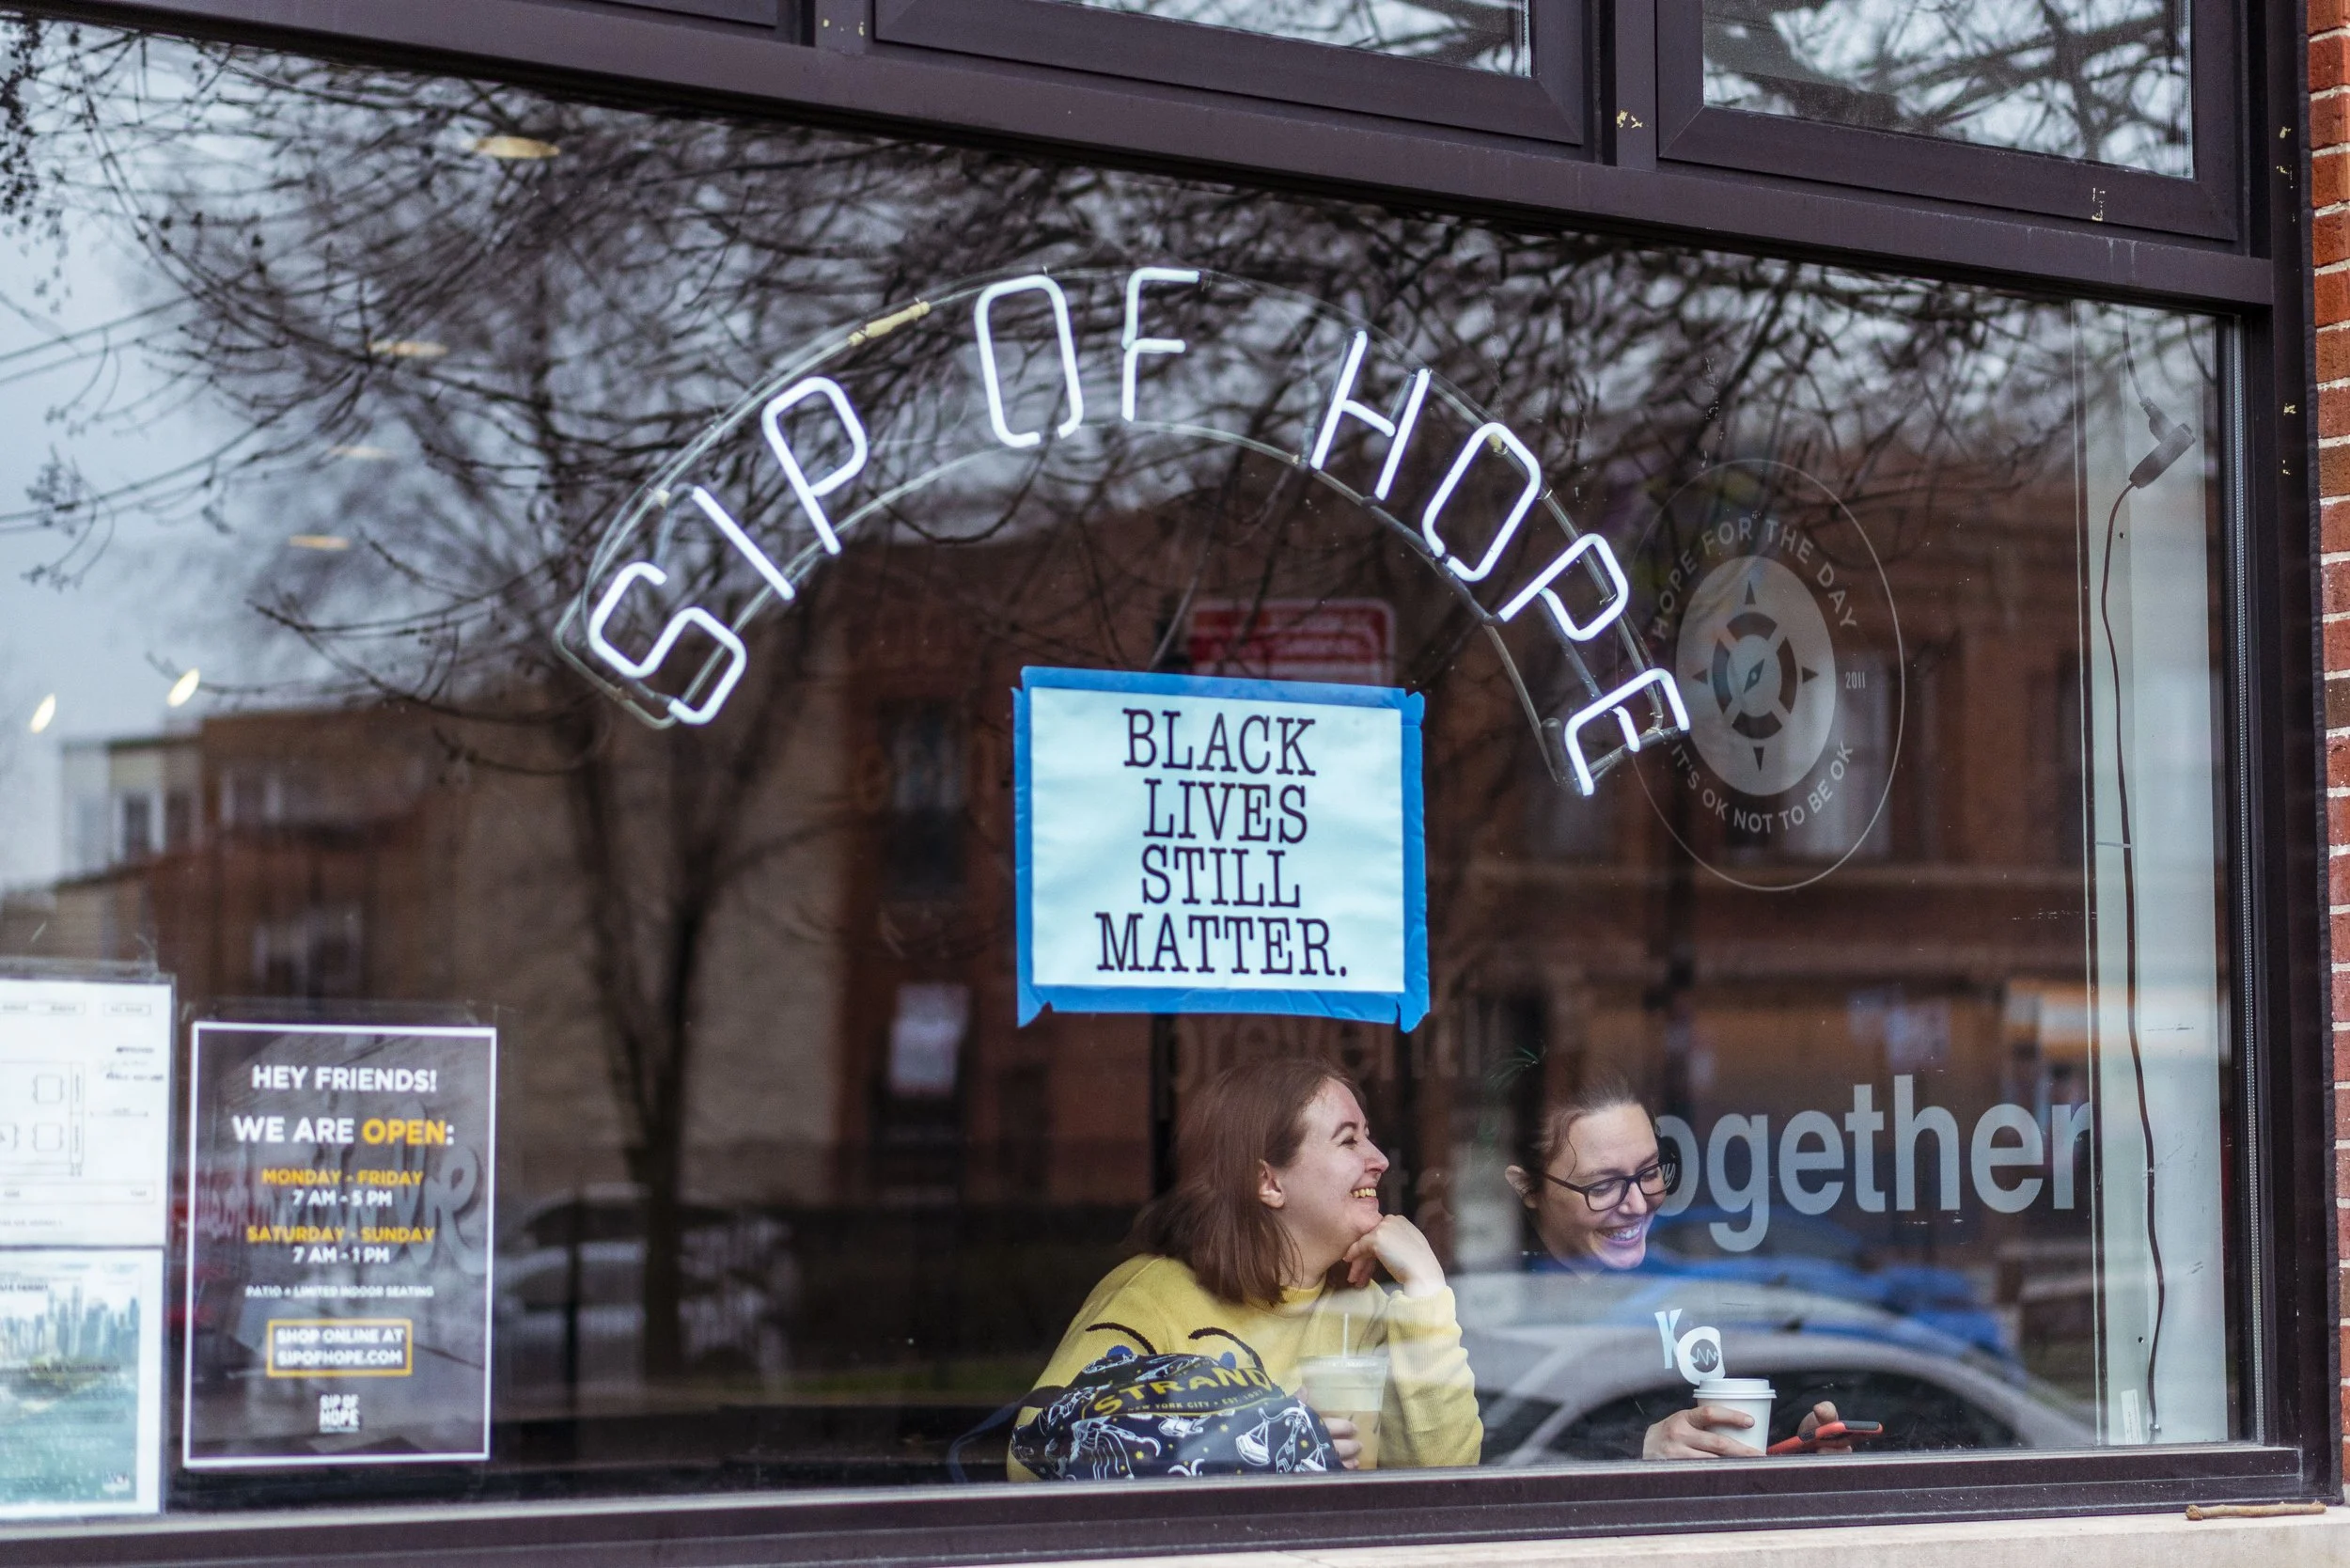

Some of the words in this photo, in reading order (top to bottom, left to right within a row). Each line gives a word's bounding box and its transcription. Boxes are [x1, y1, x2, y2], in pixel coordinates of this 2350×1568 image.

[587, 376, 870, 726] SIP
[973, 266, 1200, 448] OF
[1309, 329, 1691, 797] HOPE
[1653, 548, 1700, 641] HOPE
[1700, 517, 1753, 557] FOR
[1763, 519, 1814, 561] THE
[1816, 565, 1858, 631] DAY
[1844, 671, 1867, 689] 2011
[1121, 707, 1317, 777] BLACK
[1670, 741, 1701, 790] IT'S
[1702, 788, 1730, 823] OK
[1732, 807, 1774, 834] NOT
[1778, 804, 1806, 828] TO
[1808, 778, 1834, 815] BE
[1829, 740, 1854, 782] OK
[1142, 777, 1308, 845] LIVES
[1140, 843, 1301, 909] STILL
[1094, 911, 1348, 979] MATTER.
[251, 1064, 308, 1090] HEY
[315, 1066, 437, 1093] FRIENDS!
[231, 1115, 285, 1142] WE
[292, 1117, 354, 1144] ARE
[362, 1118, 455, 1146] OPEN:
[261, 1168, 342, 1186] MONDAY
[357, 1169, 424, 1186] FRIDAY
[1654, 1074, 2092, 1252] ogether
[292, 1189, 305, 1206] 7
[307, 1189, 337, 1206] AM
[351, 1189, 364, 1207] 5
[367, 1190, 393, 1207] PM
[246, 1225, 346, 1243] SATURDAY
[360, 1226, 435, 1243] SUNDAY
[292, 1247, 305, 1263] 7
[307, 1247, 337, 1263] AM
[352, 1247, 360, 1262] 1
[363, 1247, 391, 1263] PM
[244, 1285, 282, 1297] PATIO
[385, 1285, 435, 1297] SEATING
[275, 1328, 321, 1344] SHOP
[321, 1327, 380, 1344] ONLINE
[382, 1328, 405, 1343] AT
[276, 1349, 404, 1366] SIPOFHOPE.COM
[1093, 1367, 1274, 1417] STRAND
[1155, 1402, 1183, 1410] YORK
[1186, 1401, 1211, 1409] CITY
